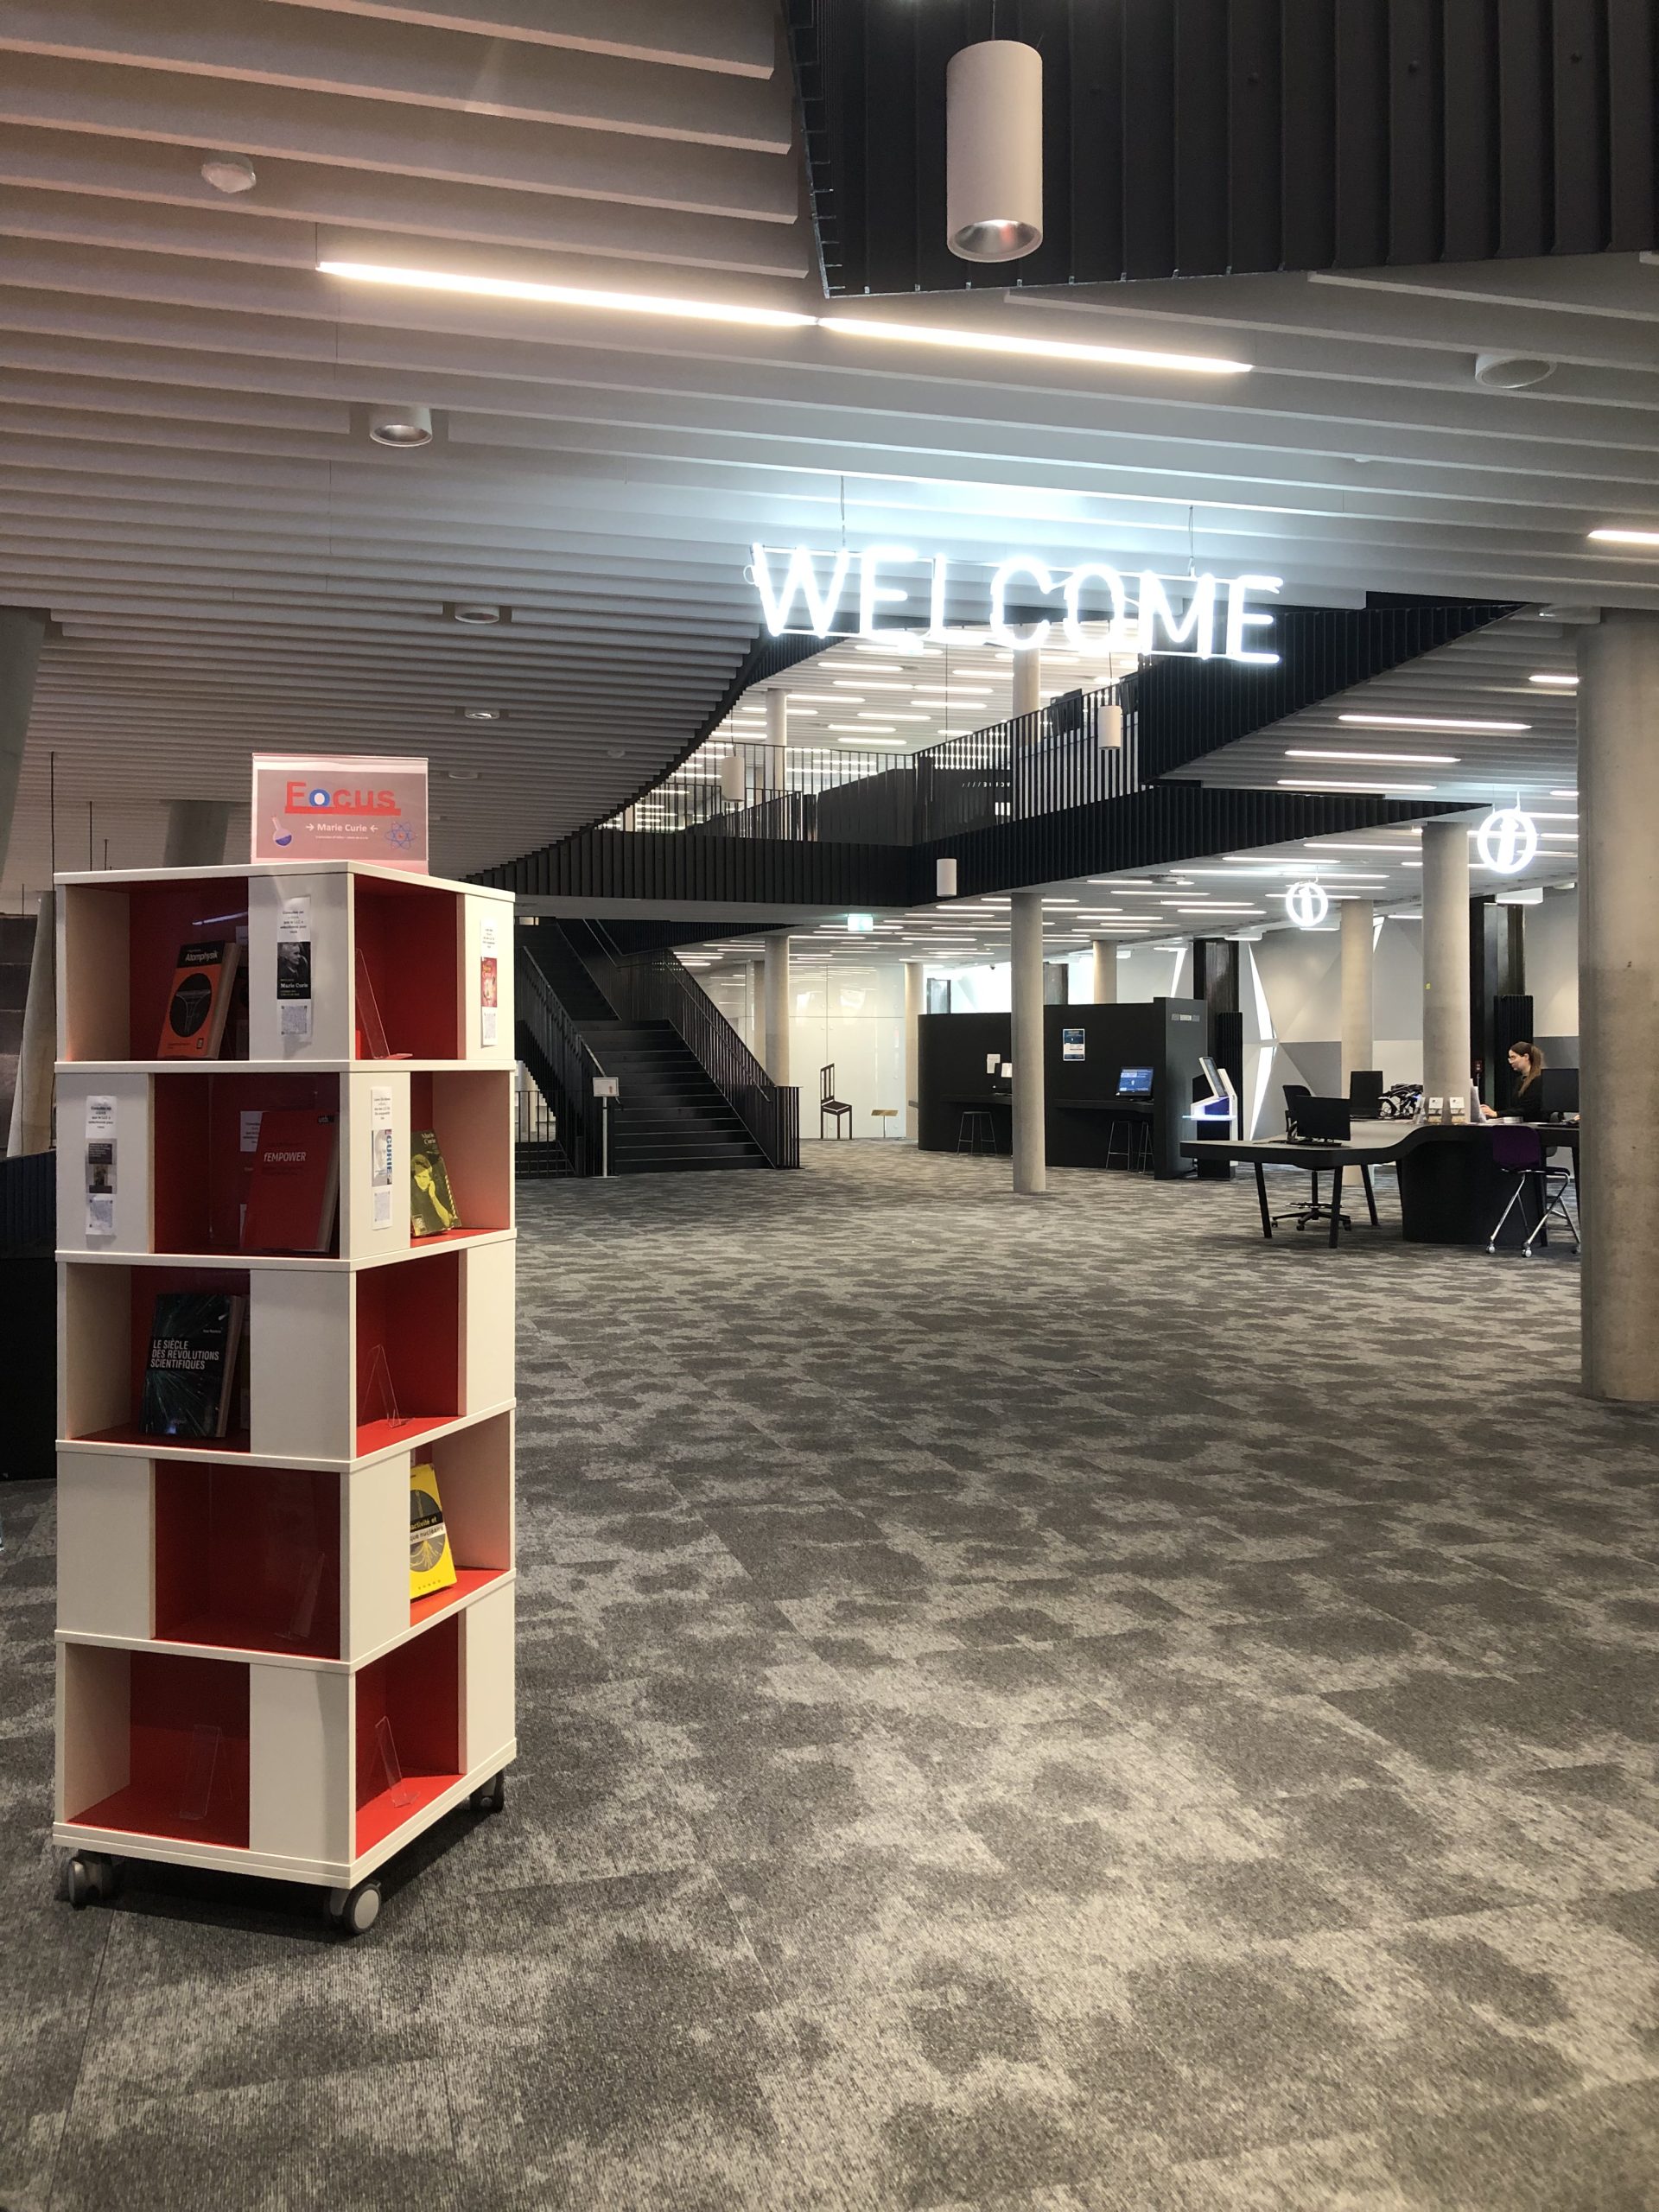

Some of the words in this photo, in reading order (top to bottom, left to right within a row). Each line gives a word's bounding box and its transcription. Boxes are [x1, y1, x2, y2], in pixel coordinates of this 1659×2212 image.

[752, 543, 1284, 663] WELCOME
[345, 823, 367, 832] Curie
[185, 951, 218, 963] Atomphysik
[264, 1152, 307, 1162] fEMPOWER
[153, 1339, 162, 1349] LE
[163, 1338, 189, 1350] SIÈCLE
[152, 1349, 166, 1359] DES
[150, 1358, 206, 1370] SCIENTIFIQUES
